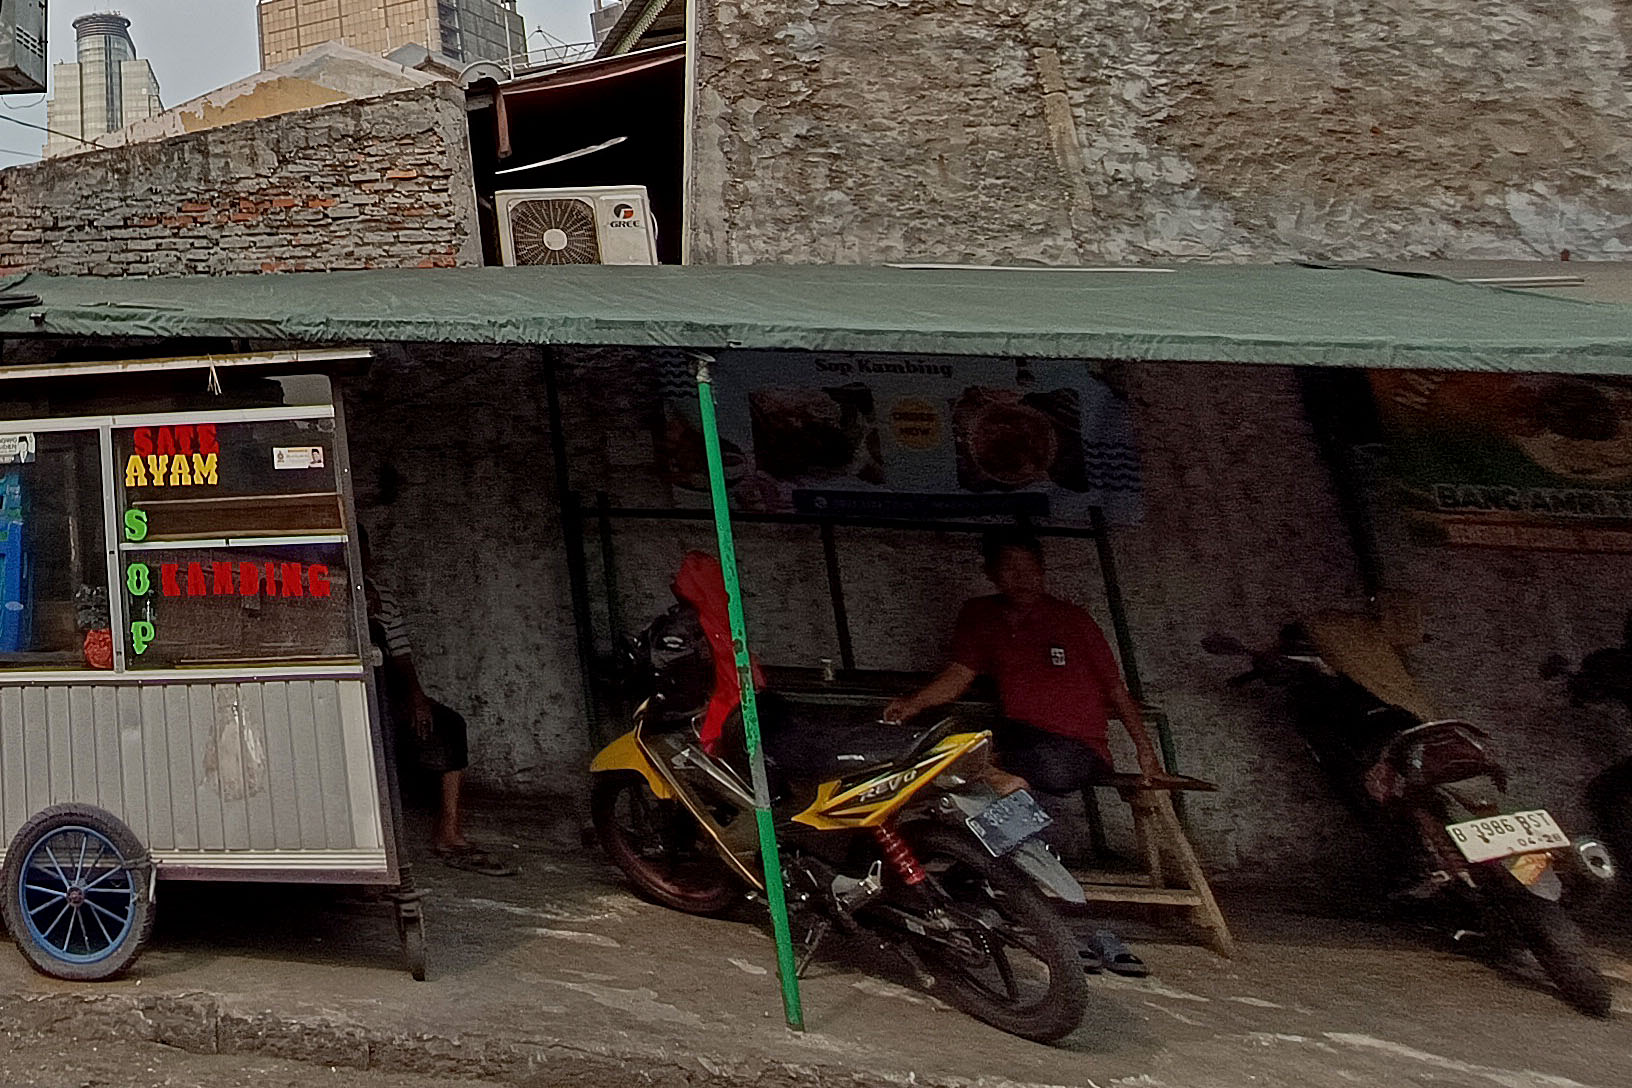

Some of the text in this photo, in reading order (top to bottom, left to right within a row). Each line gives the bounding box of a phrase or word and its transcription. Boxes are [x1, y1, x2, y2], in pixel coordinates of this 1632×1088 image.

[609, 220, 640, 228] GREE
[815, 358, 953, 378] Sop Kambing
[133, 424, 220, 457] SATE
[125, 453, 219, 487] AYAM
[124, 509, 155, 655] SOP
[1452, 812, 1551, 842] B 3986 BST
